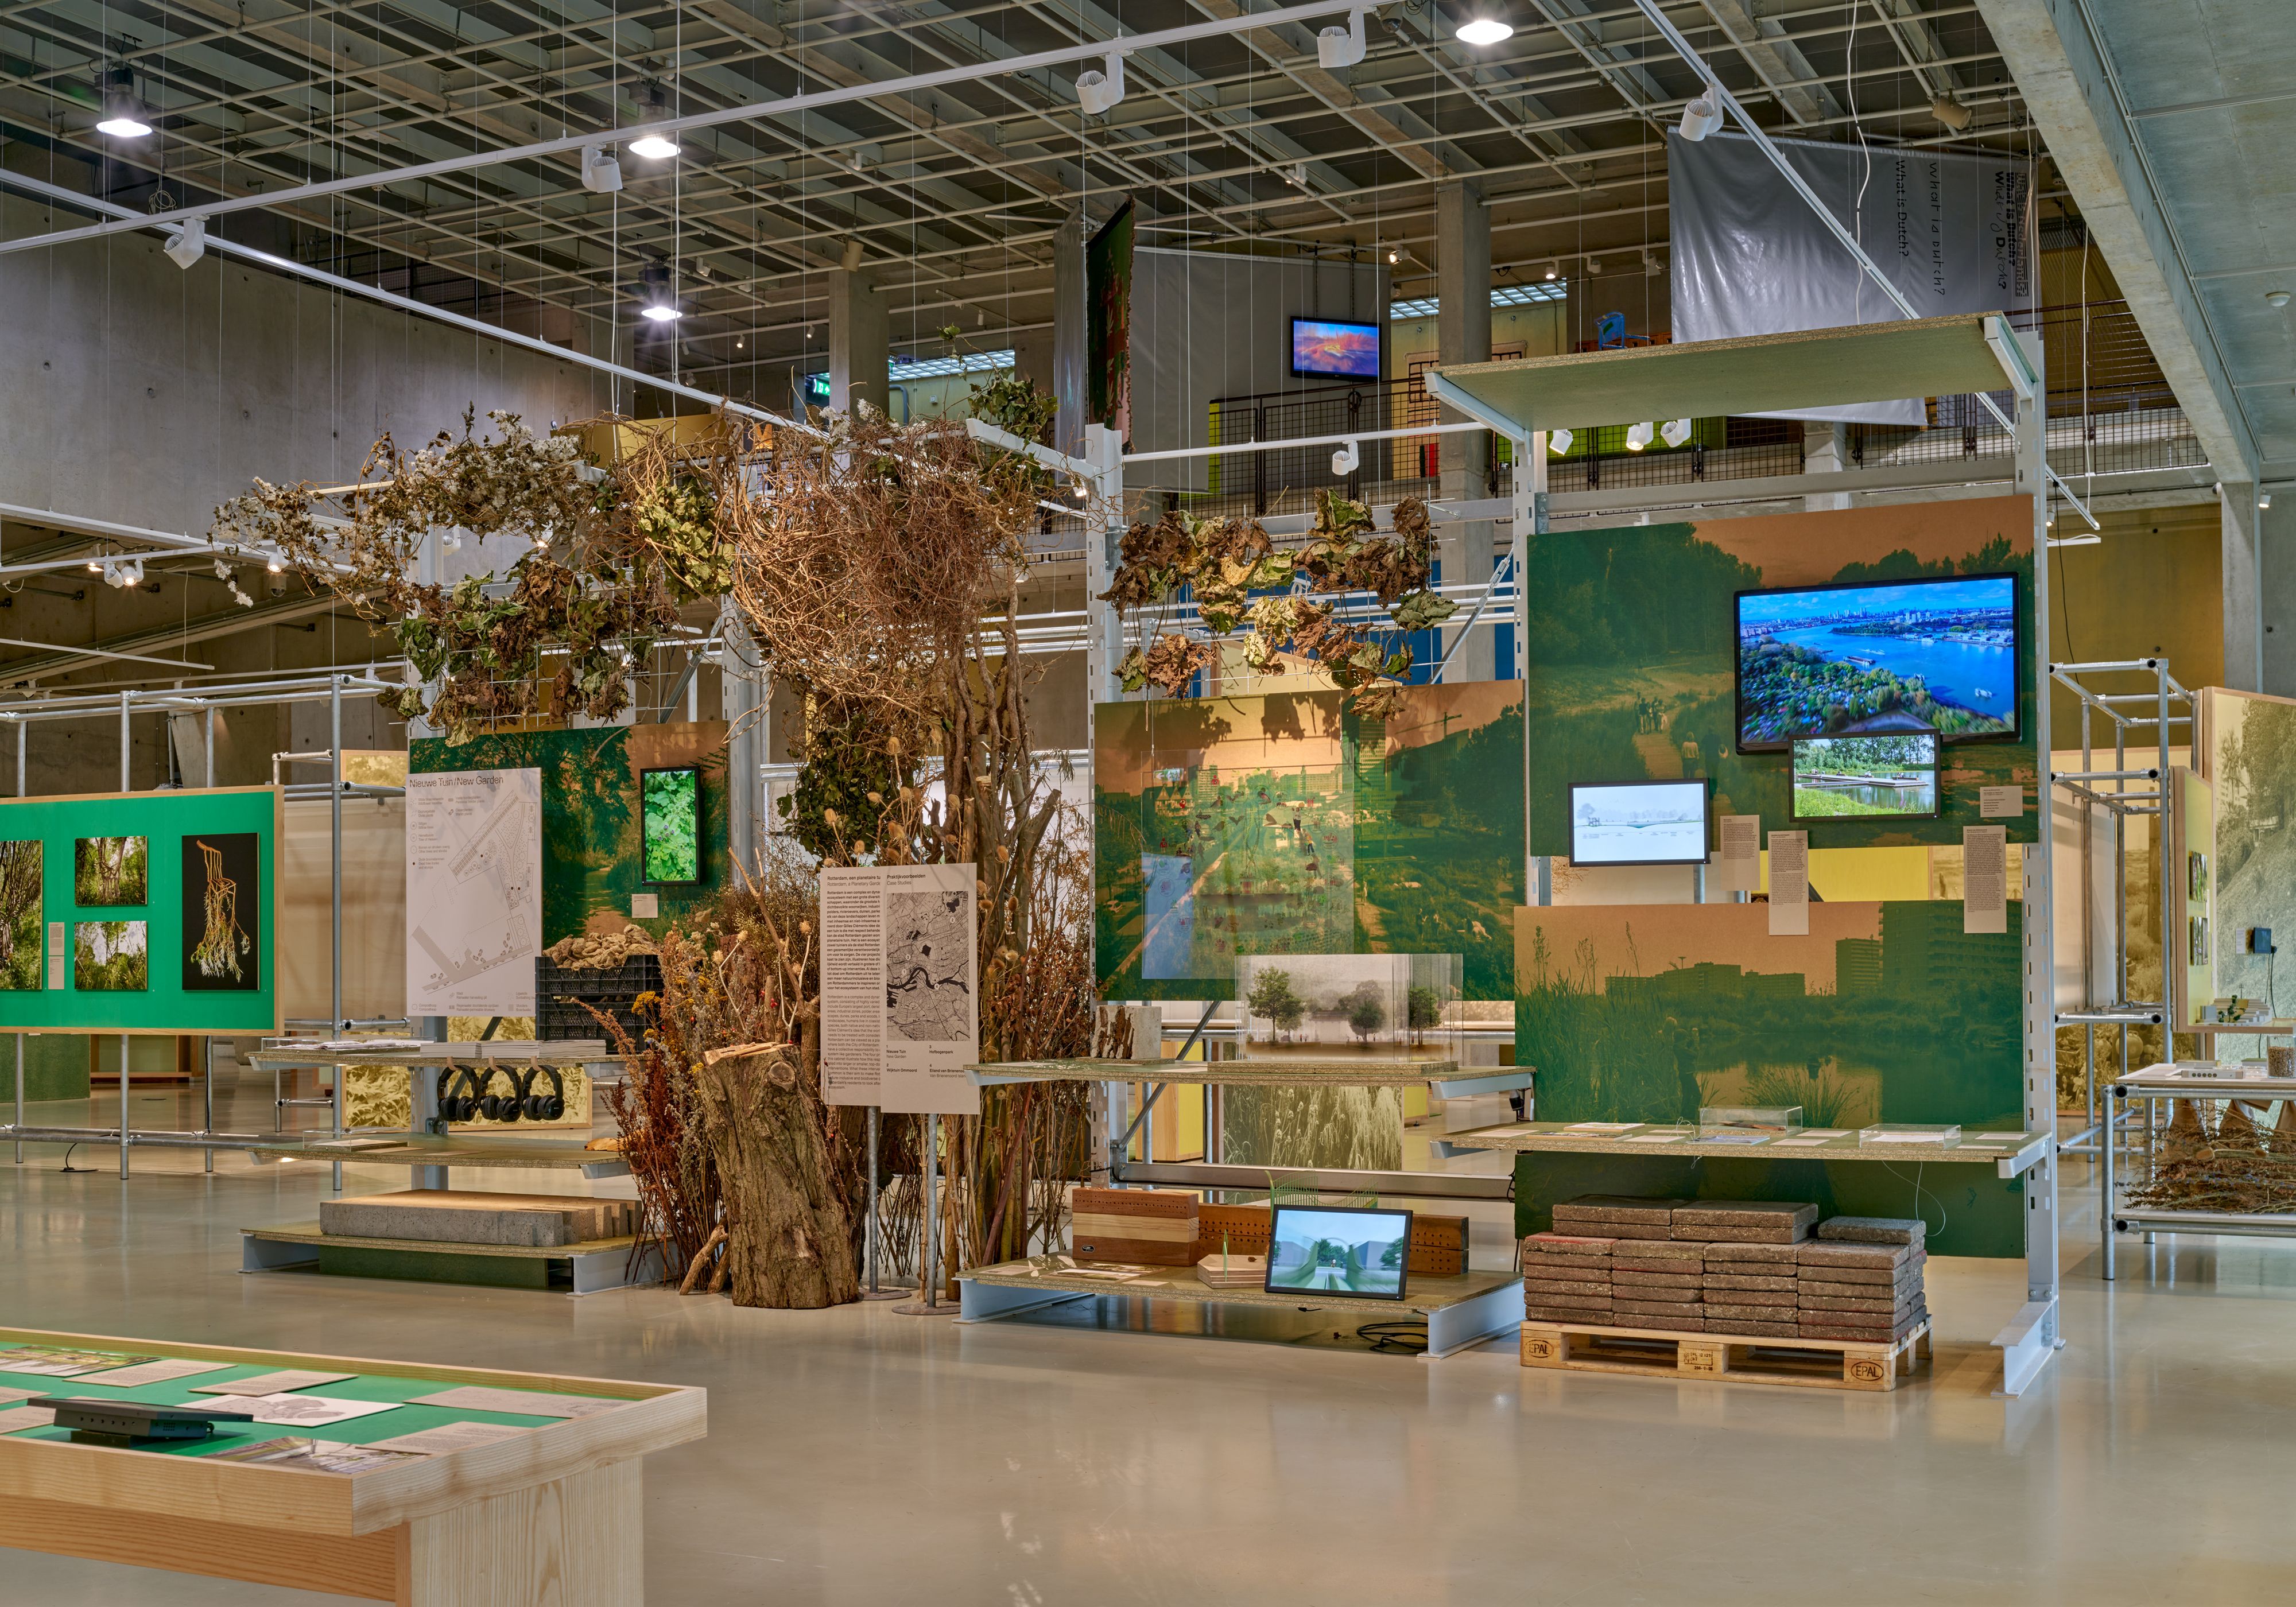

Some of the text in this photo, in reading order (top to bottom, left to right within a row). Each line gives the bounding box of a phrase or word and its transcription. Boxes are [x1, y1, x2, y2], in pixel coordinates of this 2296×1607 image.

[1896, 160, 1905, 194] What
[2006, 172, 2016, 266] What is Dutch?
[1898, 212, 1909, 257] Dutch?
[476, 776, 503, 785] Garden
[1529, 1344, 1549, 1354] EPAL
[1856, 1366, 1879, 1377] EPAL
